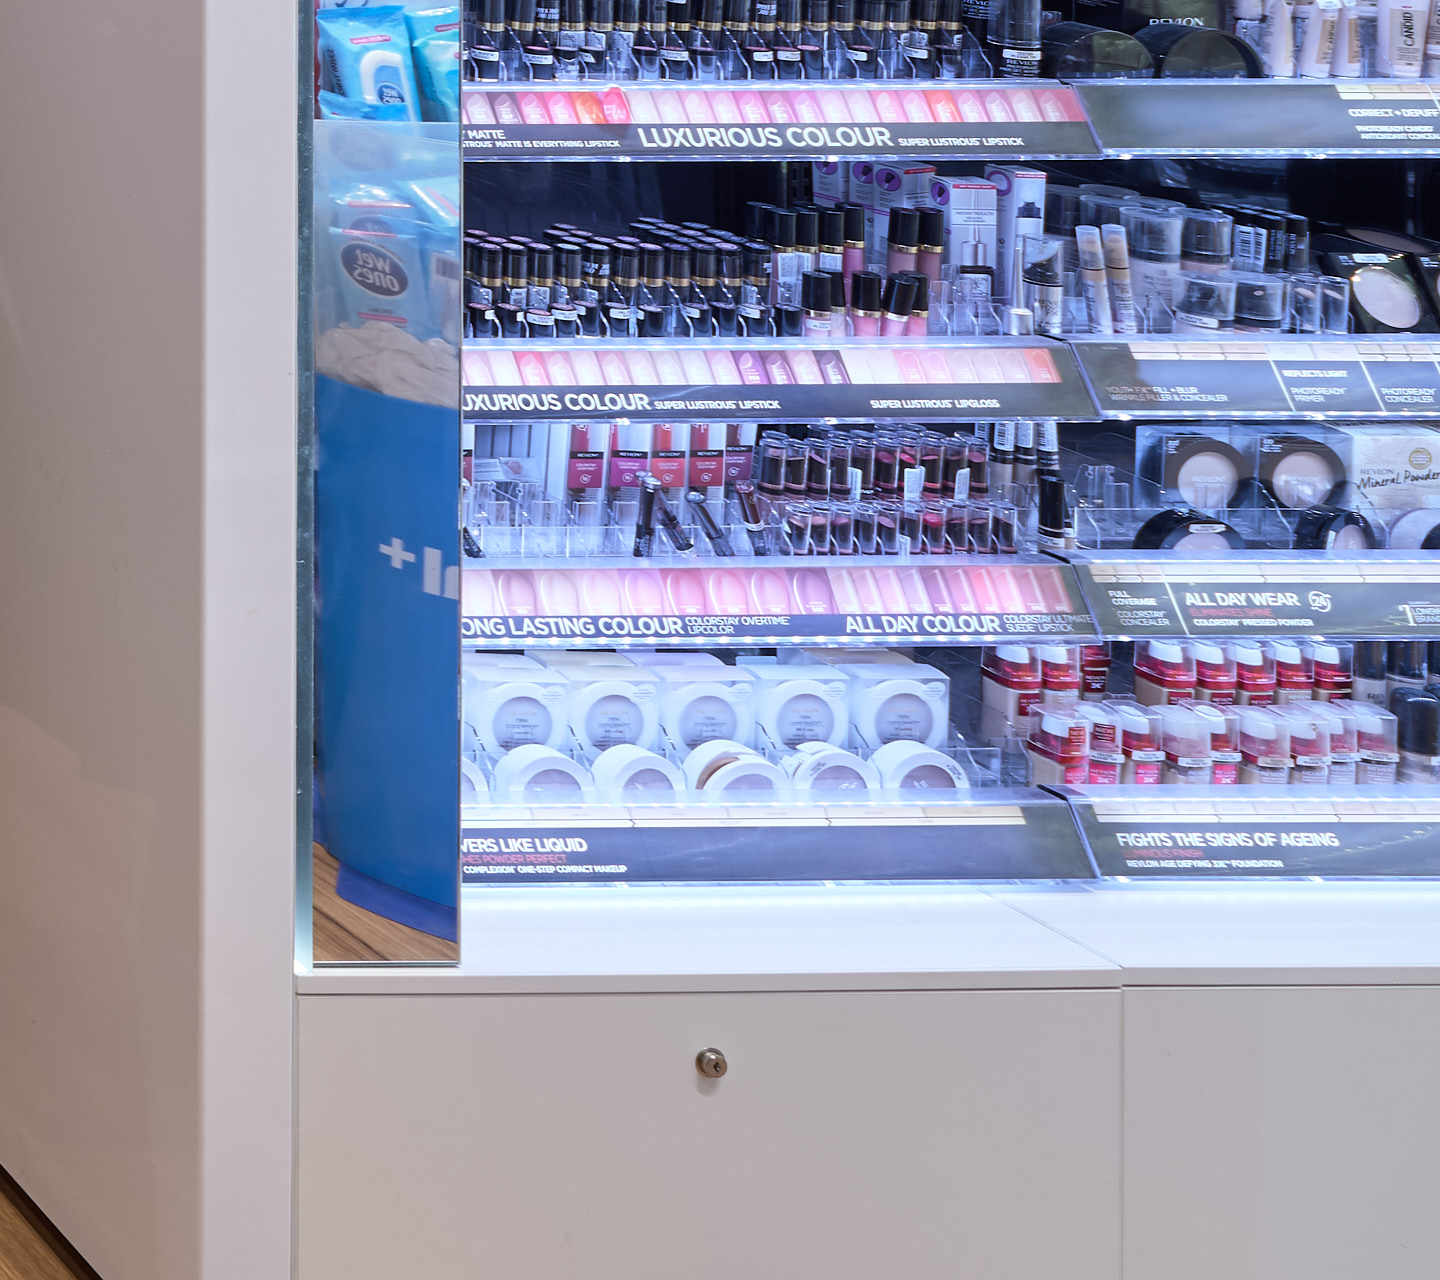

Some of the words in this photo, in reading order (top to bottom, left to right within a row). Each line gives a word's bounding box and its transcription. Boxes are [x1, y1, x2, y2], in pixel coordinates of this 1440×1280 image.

[637, 127, 782, 148] LUXURIOUS
[785, 127, 894, 147] COLOUR
[846, 616, 881, 635] ALL
[882, 616, 917, 635] DAY
[921, 616, 1002, 635] COLOUR
[1116, 833, 1173, 846] FIGHTS
[1173, 833, 1205, 846] THE
[1206, 833, 1253, 846] SIGNS
[1256, 833, 1278, 846] OF
[1280, 833, 1340, 846] AGEING
